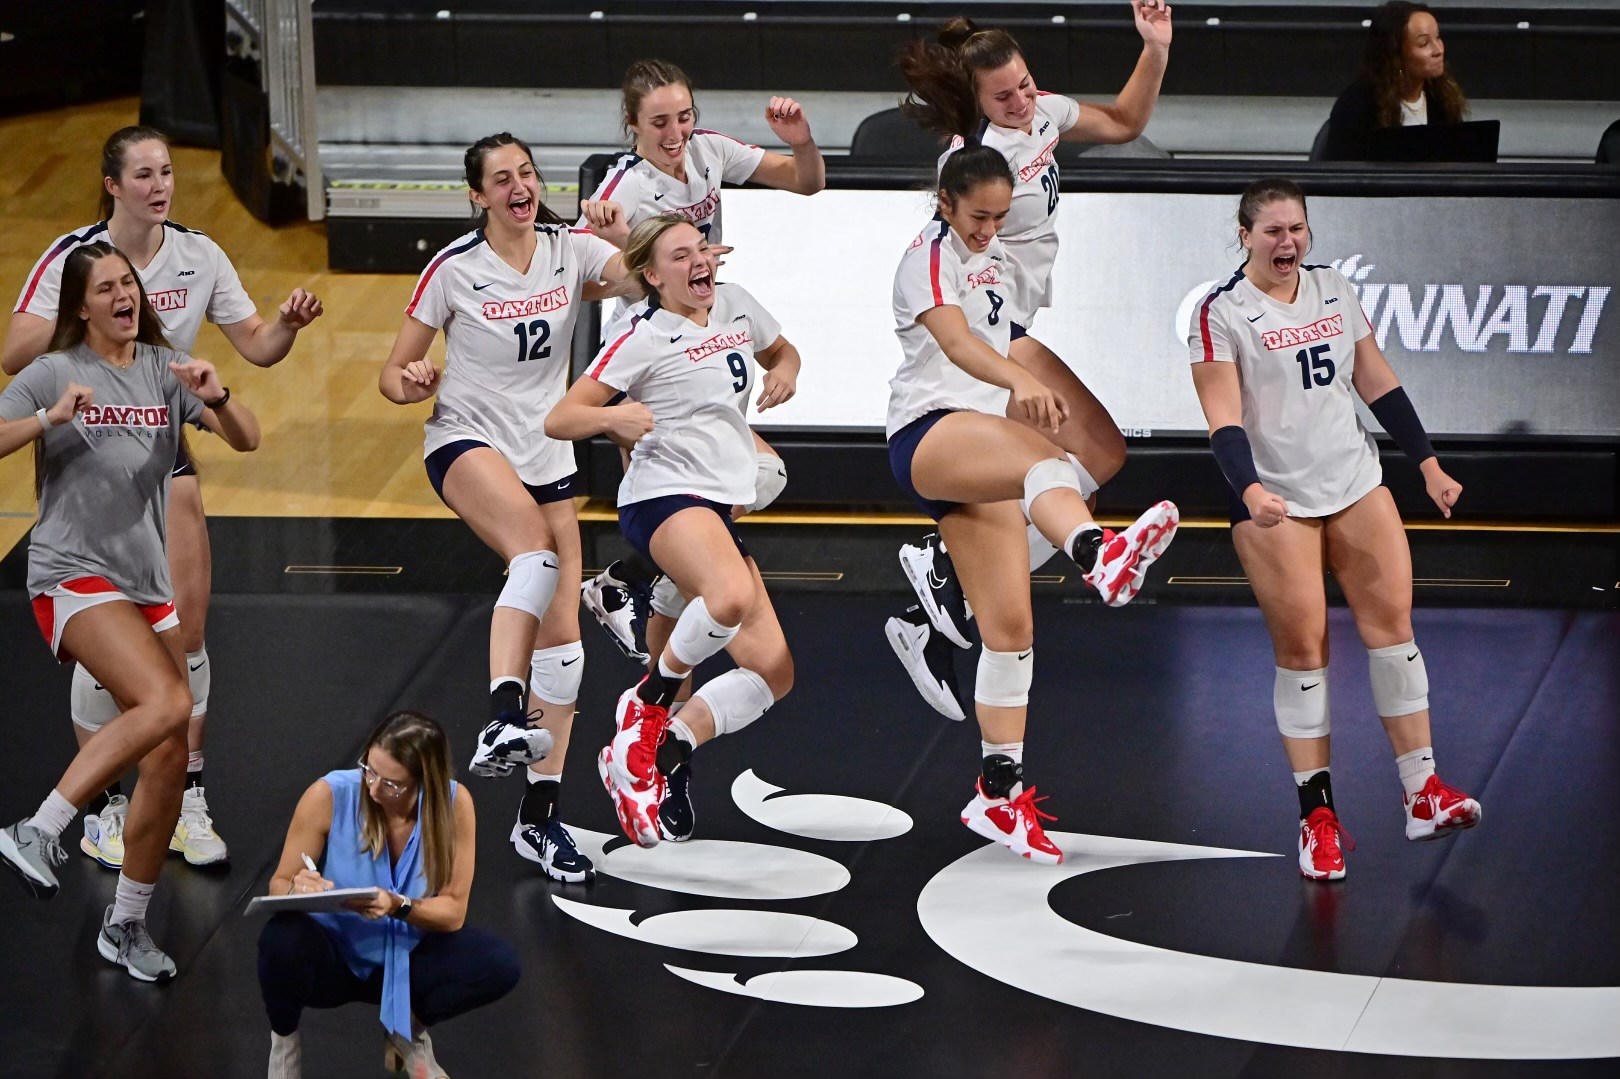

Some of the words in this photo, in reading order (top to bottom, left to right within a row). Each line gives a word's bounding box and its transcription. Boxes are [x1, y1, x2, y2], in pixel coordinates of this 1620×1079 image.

[1040, 165, 1059, 217] 20
[146, 288, 187, 312] TON
[482, 285, 569, 320] DAYTON
[513, 319, 552, 363] 12
[1261, 314, 1344, 351] DAYTON
[726, 352, 748, 394] 9
[1295, 343, 1336, 390] 15
[1121, 428, 1152, 438] NICS
